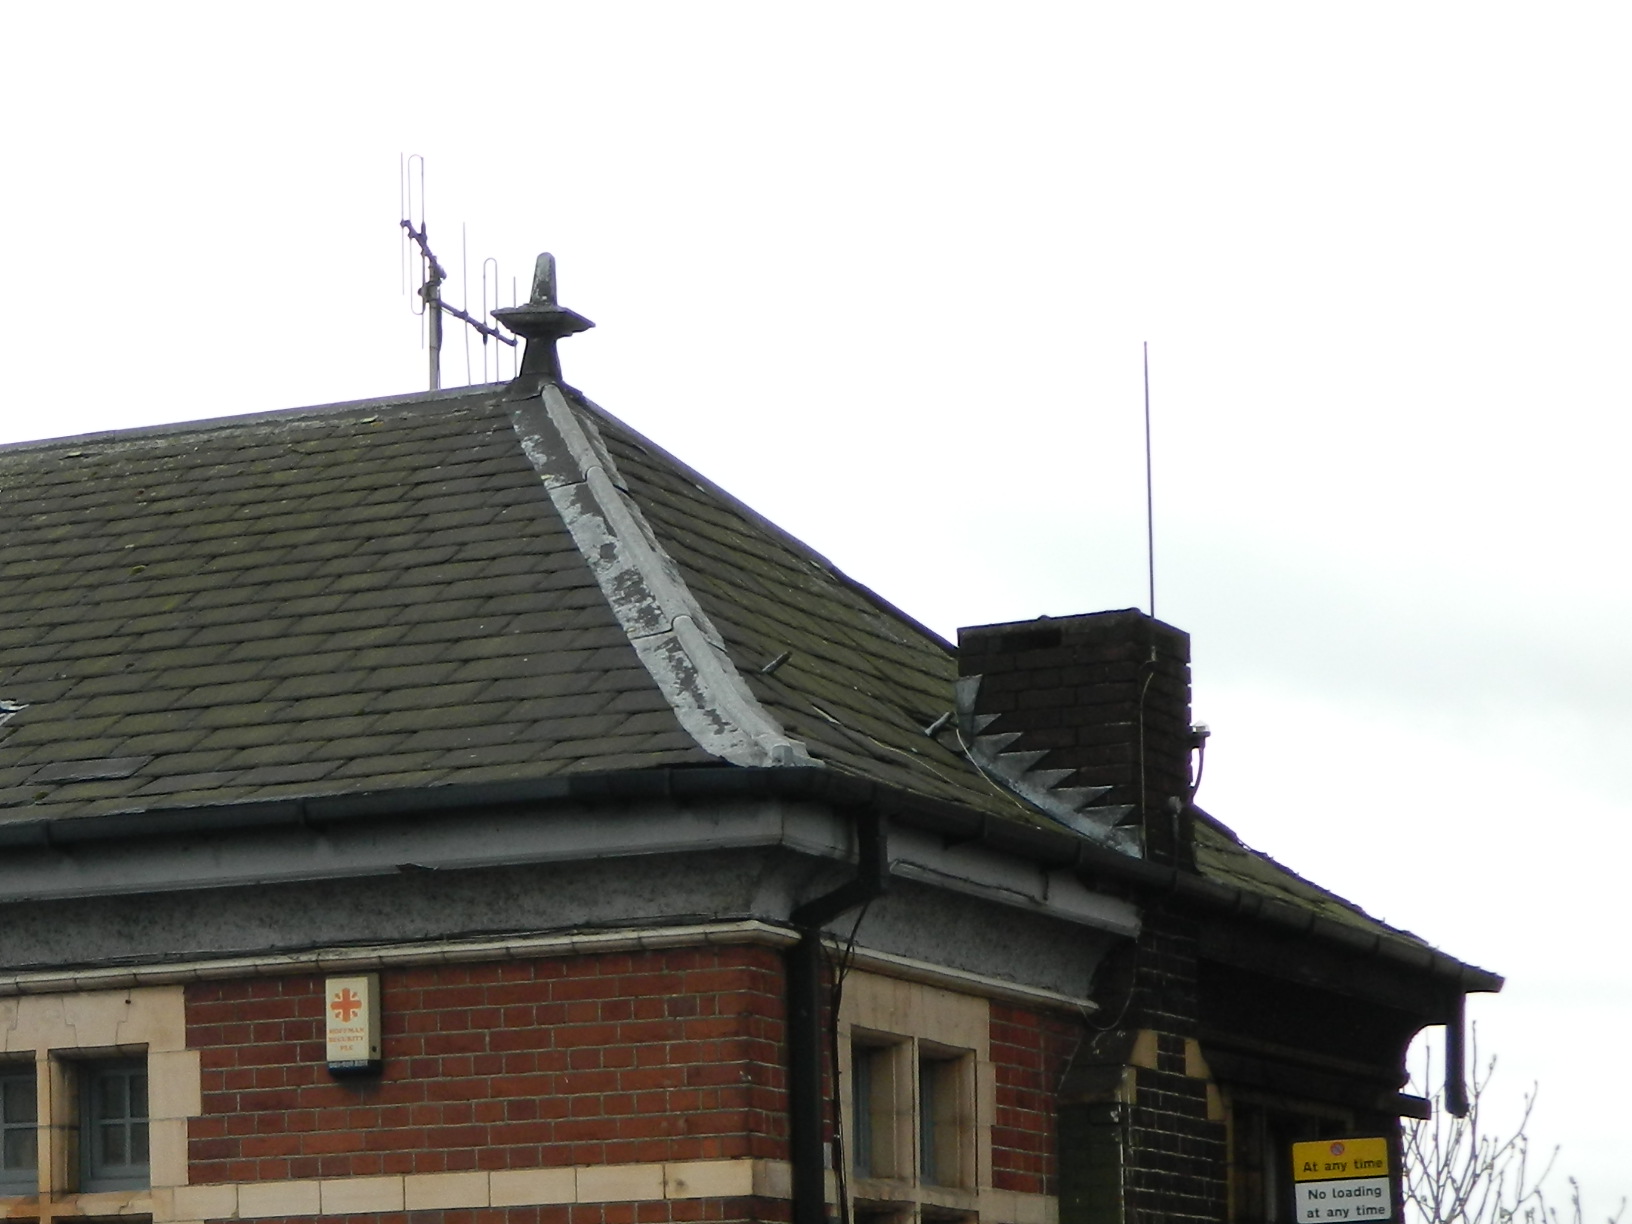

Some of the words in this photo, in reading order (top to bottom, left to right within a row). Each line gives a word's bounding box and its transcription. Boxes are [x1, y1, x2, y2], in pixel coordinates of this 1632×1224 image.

[1303, 1161, 1318, 1173] At
[1324, 1162, 1347, 1172] any
[1354, 1158, 1383, 1169] time
[1308, 1189, 1326, 1200] No
[1332, 1186, 1382, 1199] loading
[1307, 1208, 1320, 1218] at
[1327, 1208, 1349, 1219] any
[1356, 1205, 1385, 1216] time
